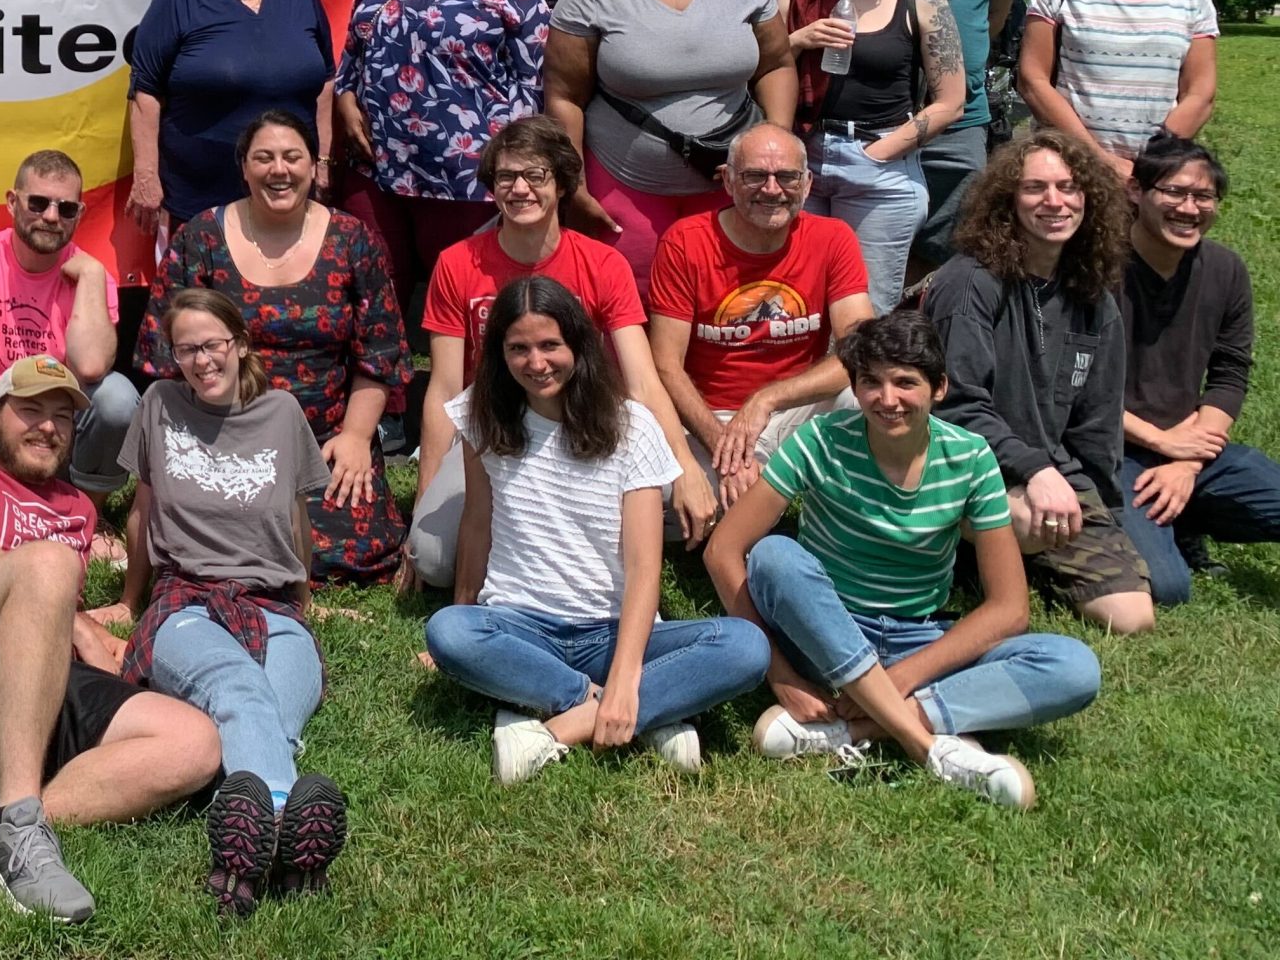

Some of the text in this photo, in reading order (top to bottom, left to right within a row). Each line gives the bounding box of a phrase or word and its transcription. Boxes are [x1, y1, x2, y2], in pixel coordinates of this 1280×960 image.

[2, 323, 53, 340] Baltimore
[769, 312, 821, 338] RIDE
[5, 337, 48, 352] Renters
